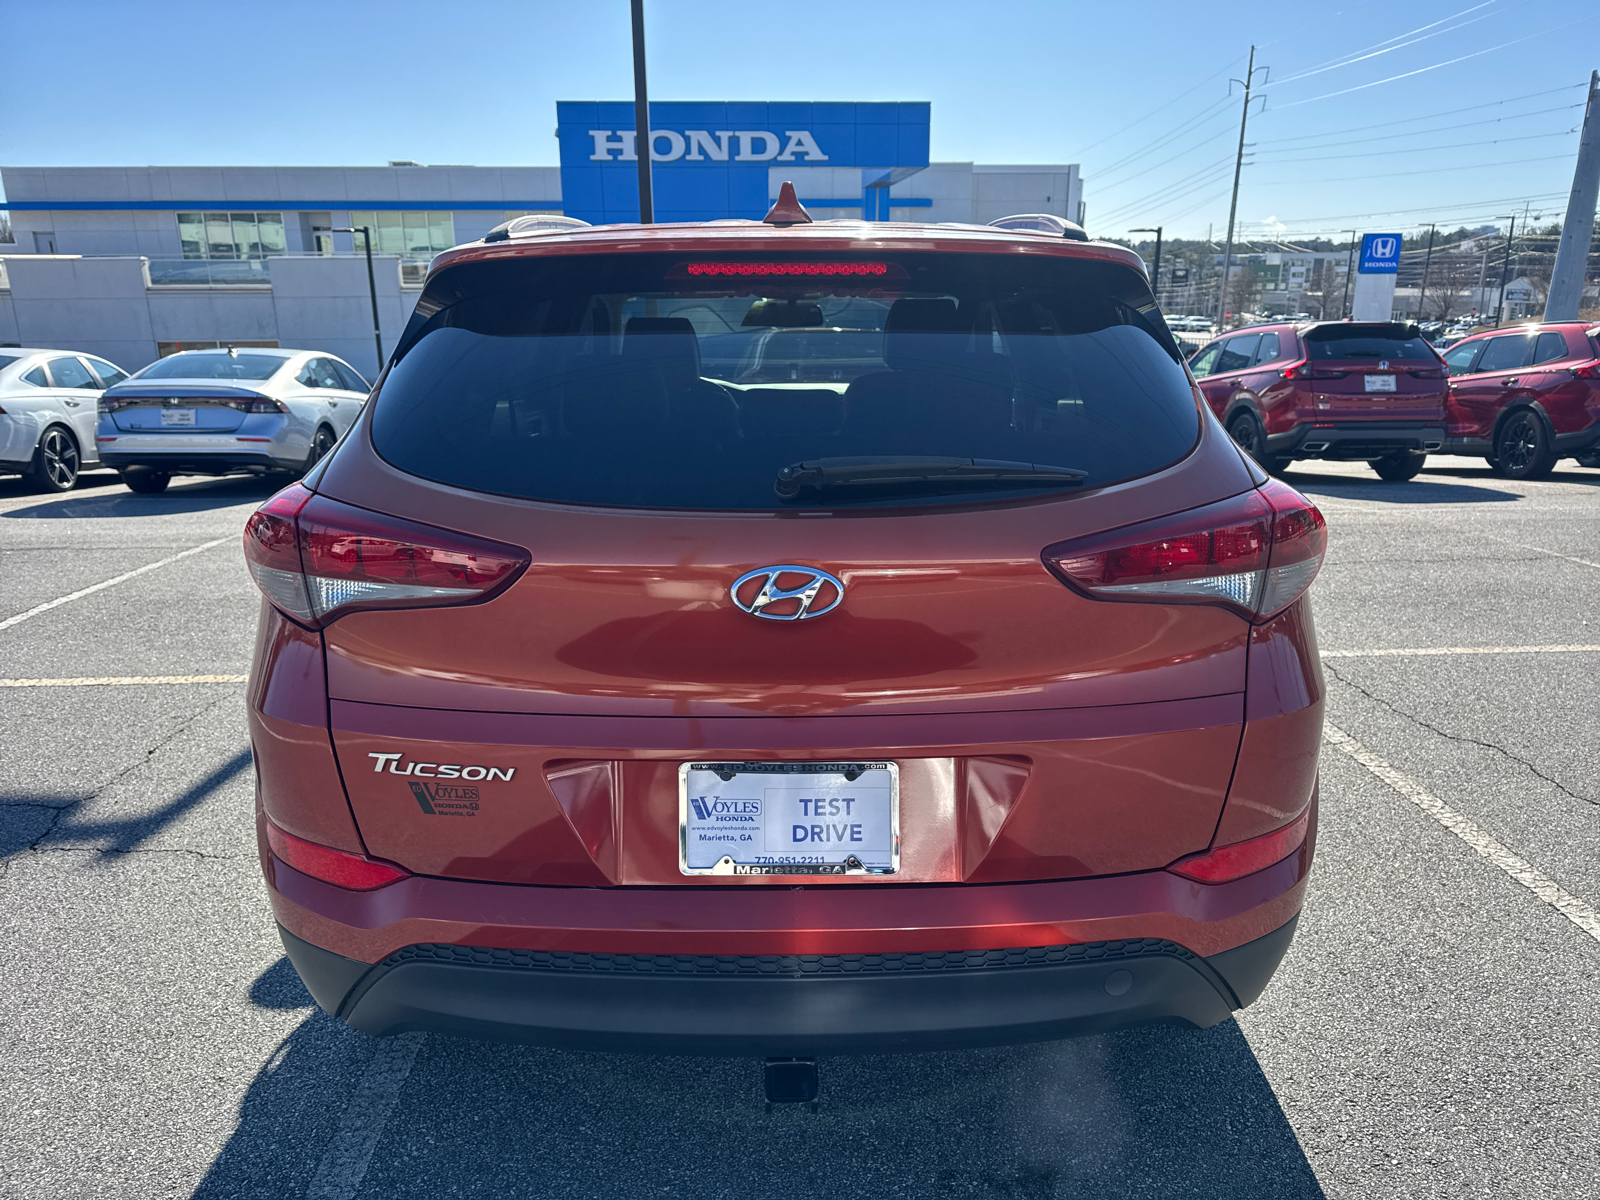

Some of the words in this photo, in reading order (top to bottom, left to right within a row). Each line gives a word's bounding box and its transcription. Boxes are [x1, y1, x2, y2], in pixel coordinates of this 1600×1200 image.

[588, 129, 829, 162] HONDA
[367, 752, 516, 782] TUCSON
[422, 782, 478, 802] VOYLES
[699, 795, 759, 818] VOYLES
[799, 798, 855, 816] TEST
[699, 834, 737, 842] Marietta,
[792, 824, 863, 842] DRIVE
[754, 856, 825, 864] 770-951-2211
[736, 865, 813, 874] Marietta,
[819, 866, 844, 874] GA
